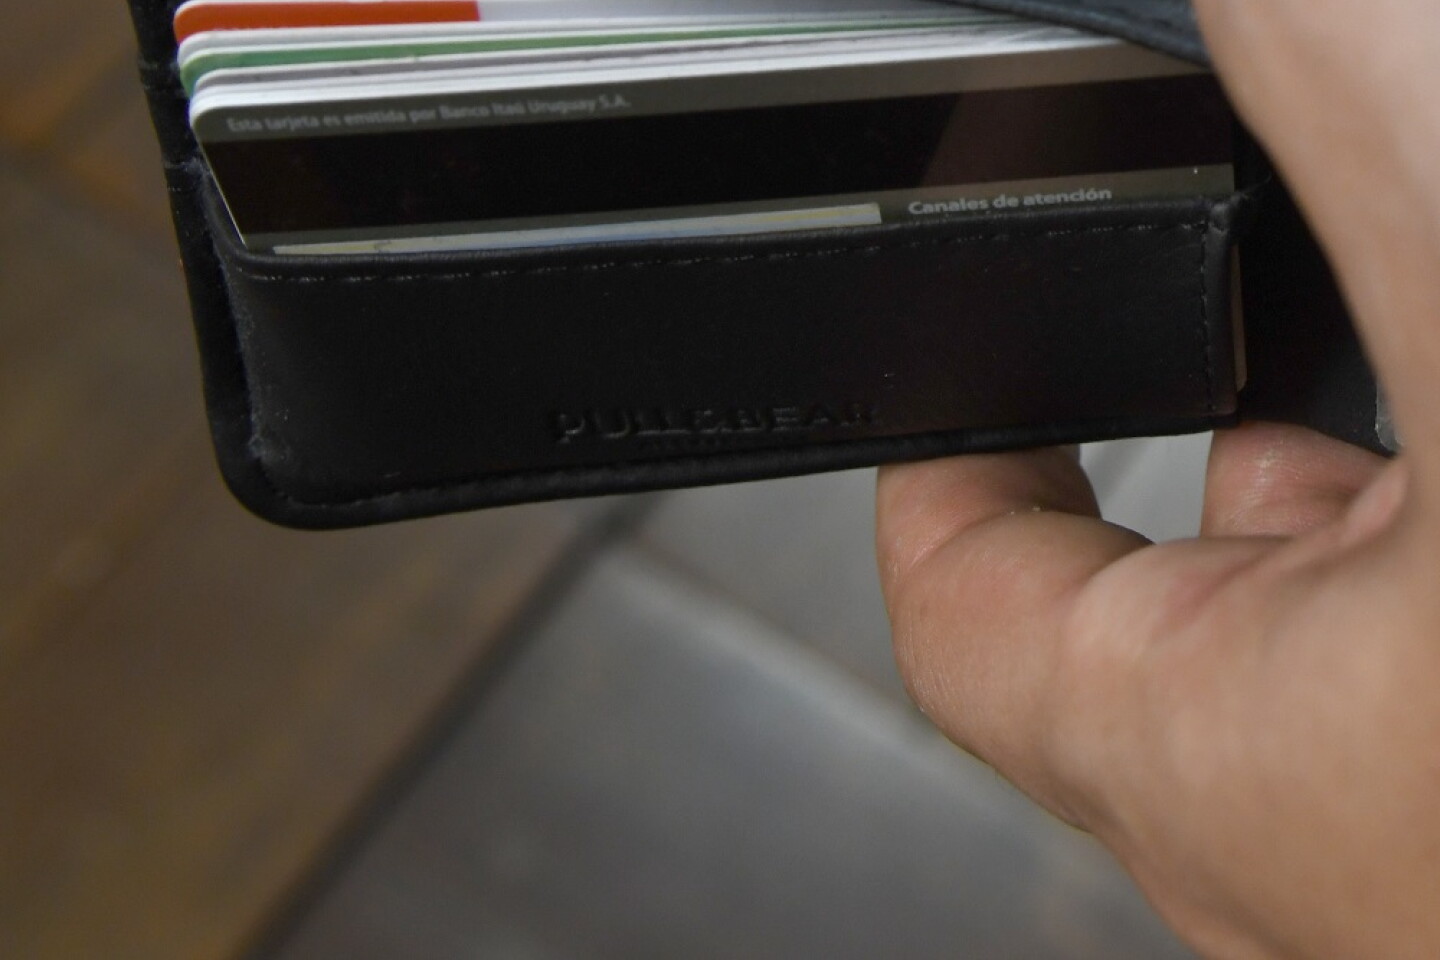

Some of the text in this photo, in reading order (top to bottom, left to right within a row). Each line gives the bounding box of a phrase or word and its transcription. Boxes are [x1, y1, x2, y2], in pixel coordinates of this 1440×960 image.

[227, 117, 263, 133] Esta
[265, 113, 319, 133] tarjeta
[323, 114, 341, 128] es
[343, 107, 407, 127] emitida
[409, 109, 438, 125] por
[439, 102, 489, 120] Banco
[528, 96, 596, 118] Uruguay
[908, 187, 1112, 215] Canales de atención
